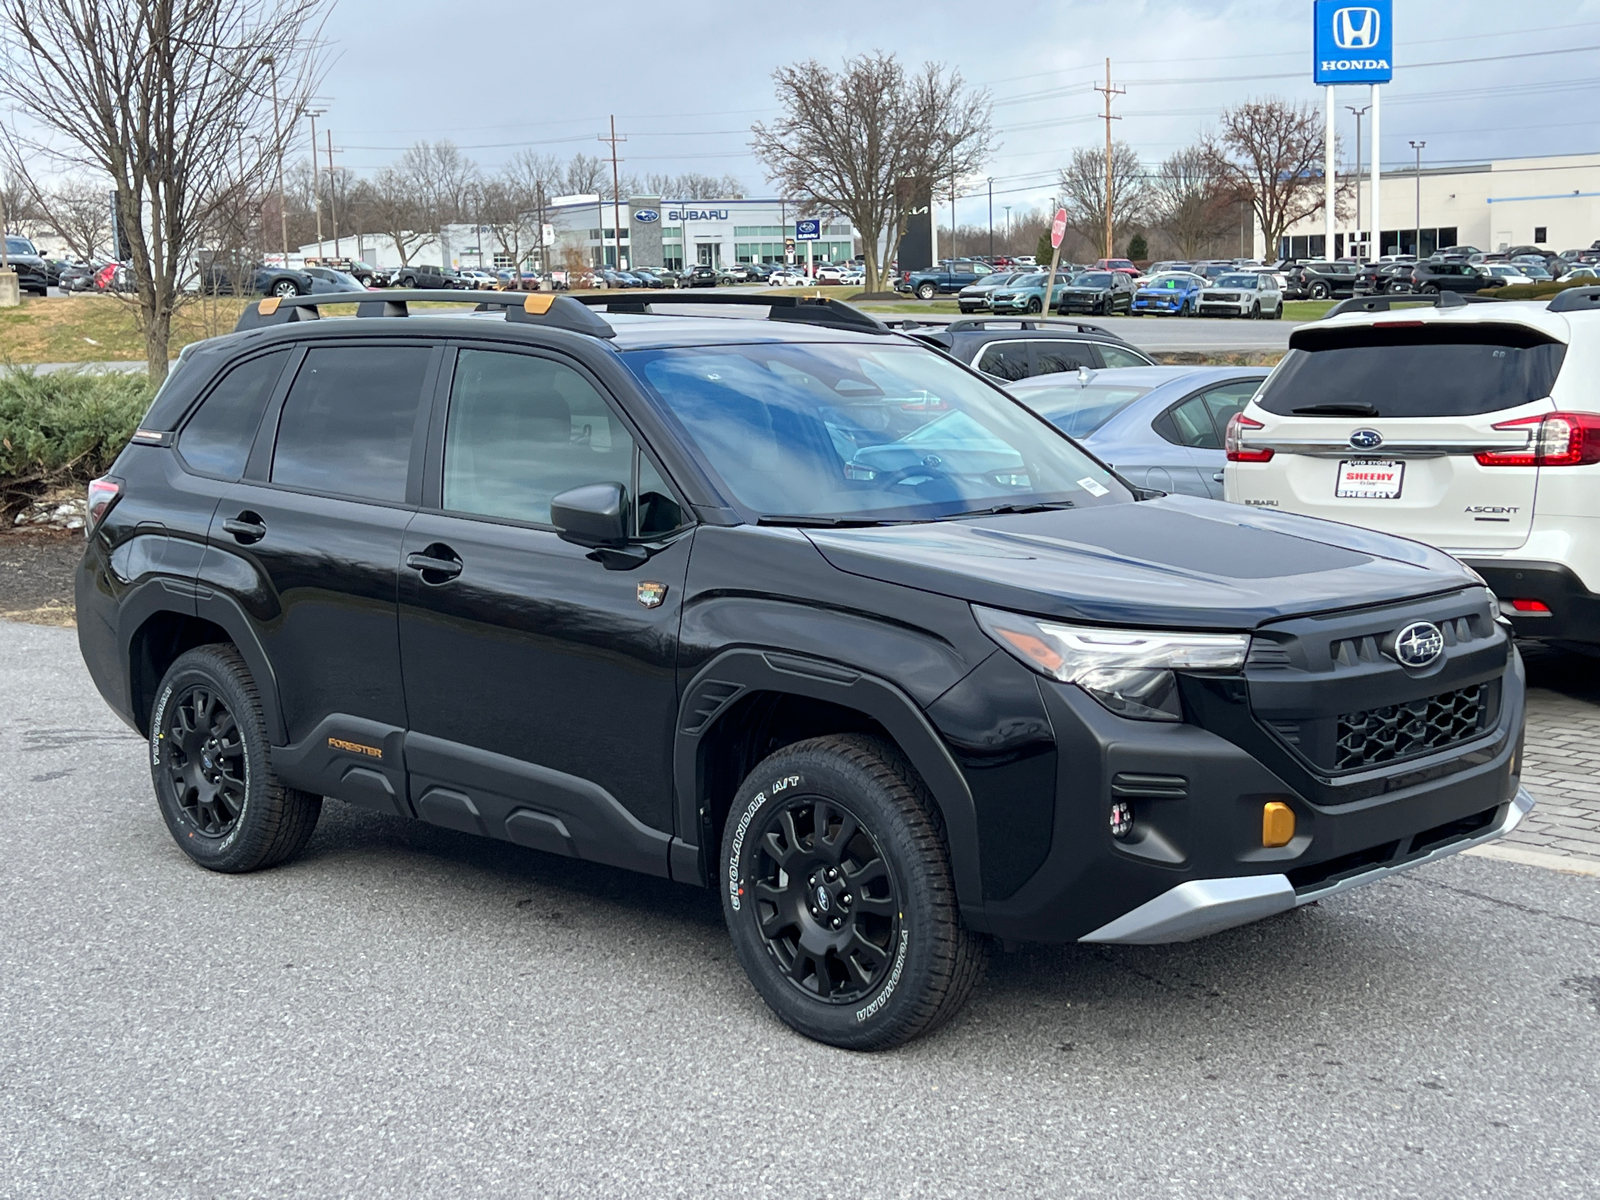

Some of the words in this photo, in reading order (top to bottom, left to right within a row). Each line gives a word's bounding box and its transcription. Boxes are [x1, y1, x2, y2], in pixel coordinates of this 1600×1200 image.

[1321, 59, 1390, 71] HONDA
[668, 209, 729, 221] SUBARU
[1346, 472, 1394, 481] SHEEHY
[1337, 489, 1398, 499] SHEEHY
[1464, 506, 1520, 514] ASCENT
[327, 737, 382, 758] FORESTER
[729, 792, 767, 911] GEOLANDAR
[772, 775, 800, 795] A/T
[856, 929, 909, 1023] YOKOHAMA
